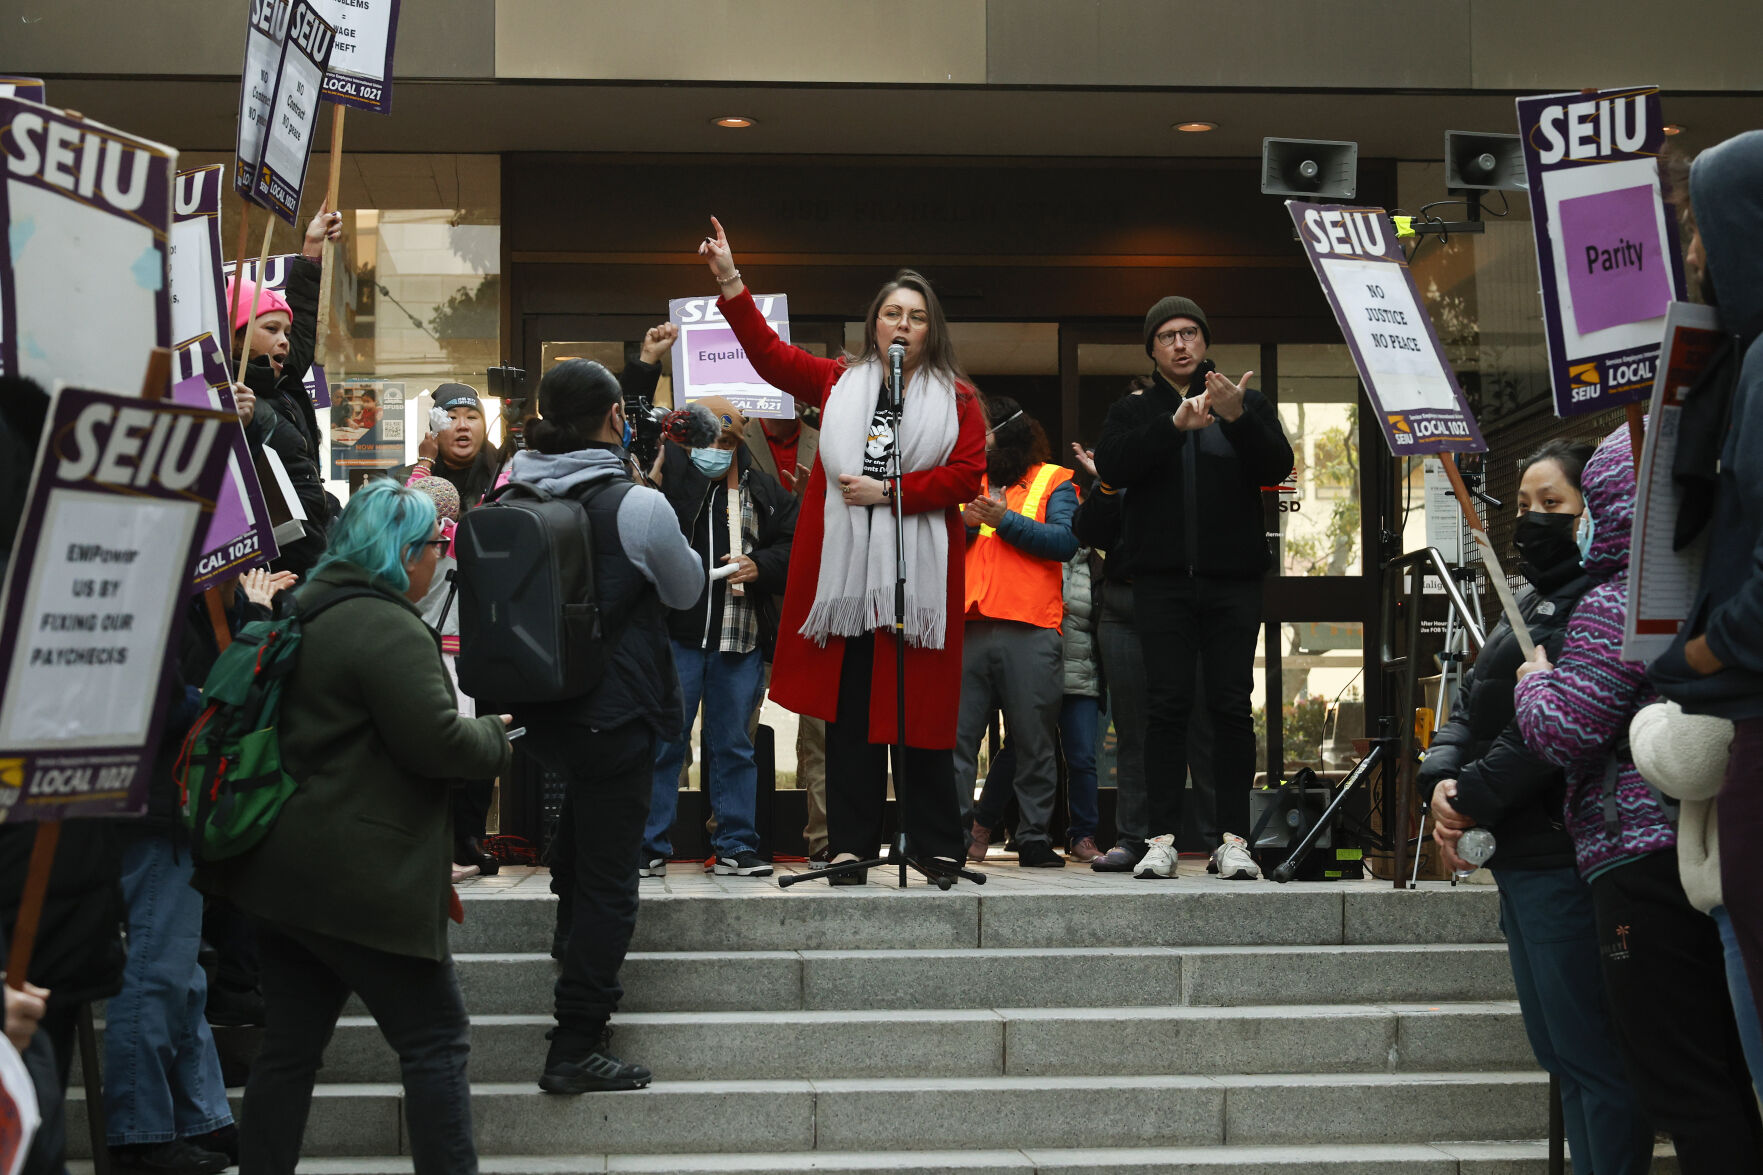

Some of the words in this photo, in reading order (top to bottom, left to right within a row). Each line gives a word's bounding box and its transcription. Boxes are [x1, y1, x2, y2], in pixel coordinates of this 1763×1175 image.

[291, 2, 332, 62] SEIU
[333, 40, 357, 53] HEFT
[260, 69, 269, 84] NO
[297, 80, 305, 96] NO
[322, 77, 357, 95] LOCAL
[360, 86, 382, 101] 1021
[248, 105, 256, 121] NO
[287, 94, 306, 120] Contract
[282, 113, 290, 129] NO
[1539, 95, 1647, 165] SEIU
[288, 123, 301, 141] peace
[8, 112, 151, 211] SEIU
[270, 181, 285, 203] LOCAL
[285, 193, 297, 211] 1021
[1305, 209, 1386, 256] SEIU
[1585, 238, 1643, 275] Parity
[1366, 284, 1385, 299] NO
[682, 297, 774, 322] SEU
[1365, 308, 1408, 325] JUSTICE
[1372, 333, 1389, 349] NO
[1390, 335, 1421, 352] PEACE
[1608, 360, 1652, 387] LOCAL
[1571, 384, 1600, 403] SEIU
[731, 400, 753, 409] CAL
[756, 401, 782, 410] 1021
[1413, 420, 1450, 436] LOCAL
[1447, 421, 1470, 435] 1021
[56, 402, 221, 491] SEIU
[1394, 433, 1414, 444] SEIU
[194, 551, 226, 577] CAL
[229, 535, 259, 561] 1021
[72, 578, 96, 598] US
[98, 579, 122, 598] BY
[40, 612, 97, 632] FIXING
[100, 613, 135, 632] OUR
[30, 647, 128, 667] PAYCHECKS
[29, 768, 92, 795] LOCAL
[95, 765, 138, 790] 1021
